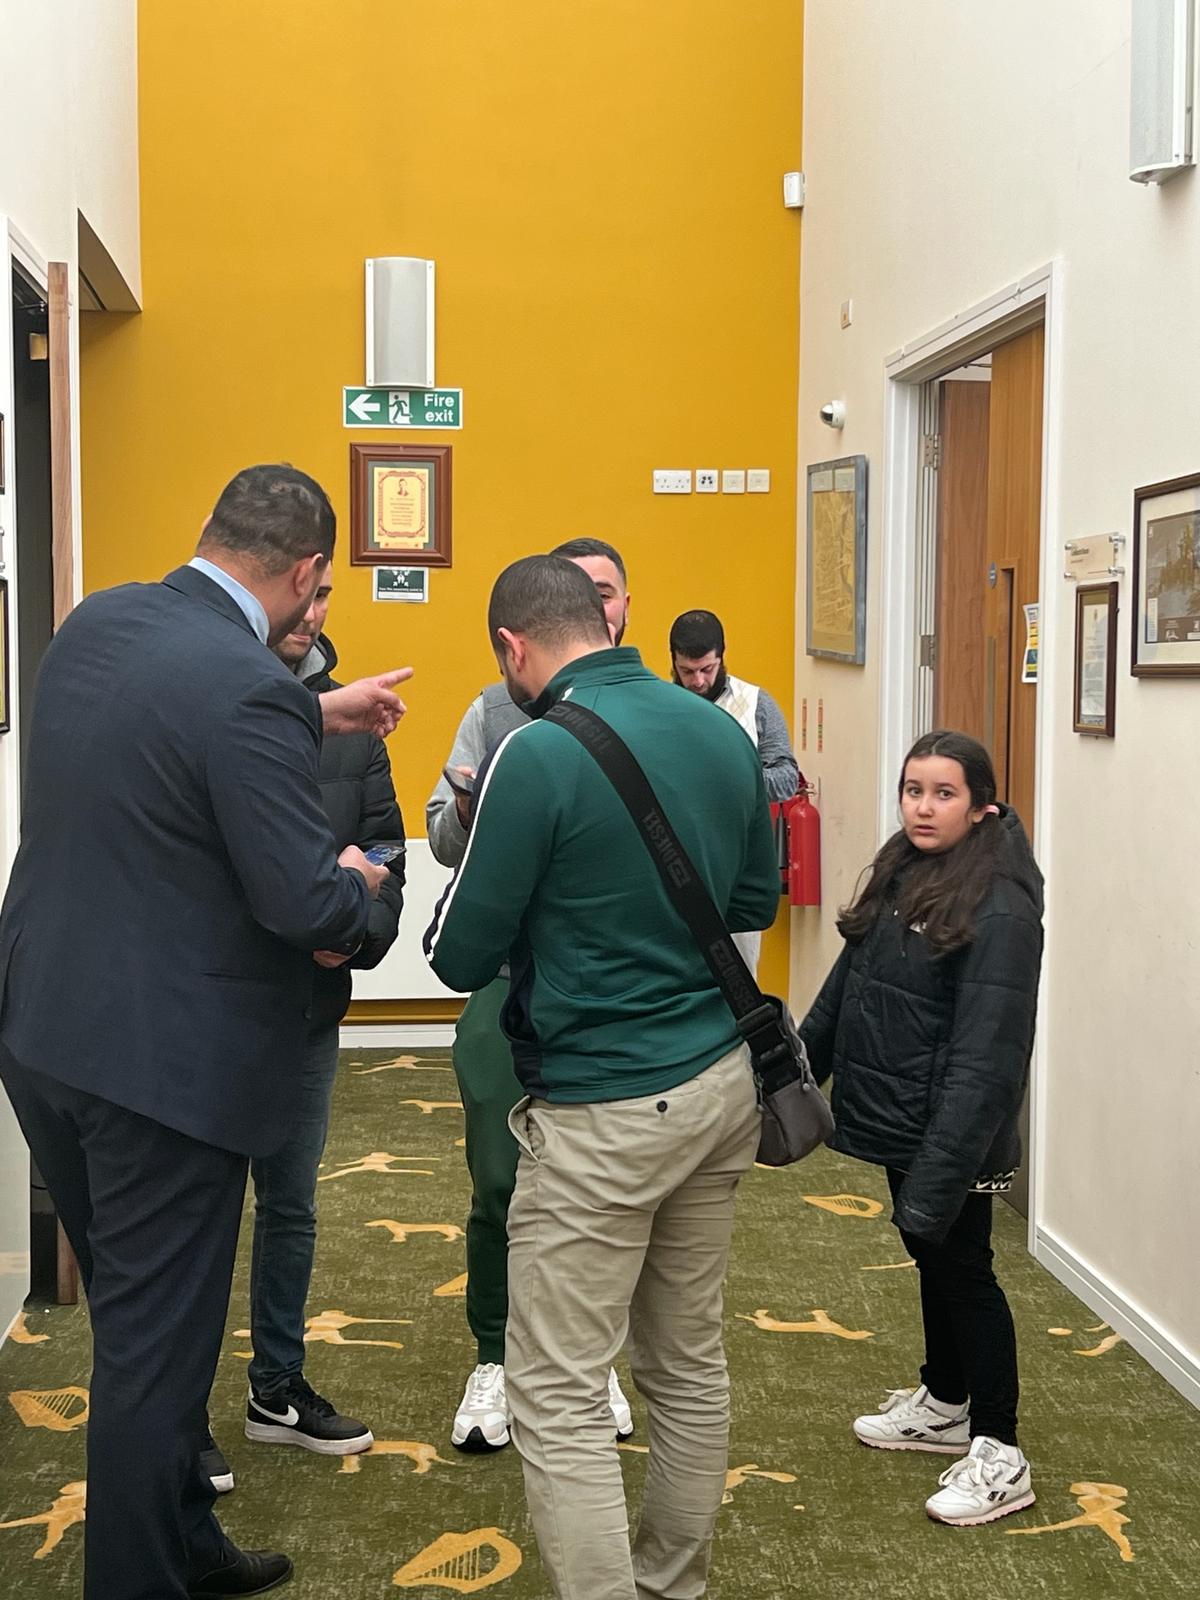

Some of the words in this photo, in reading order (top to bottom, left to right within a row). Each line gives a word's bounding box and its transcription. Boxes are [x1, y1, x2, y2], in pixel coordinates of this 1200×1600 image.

[424, 393, 455, 407] Fire
[425, 409, 454, 422] exit
[642, 808, 678, 863] DIESEL
